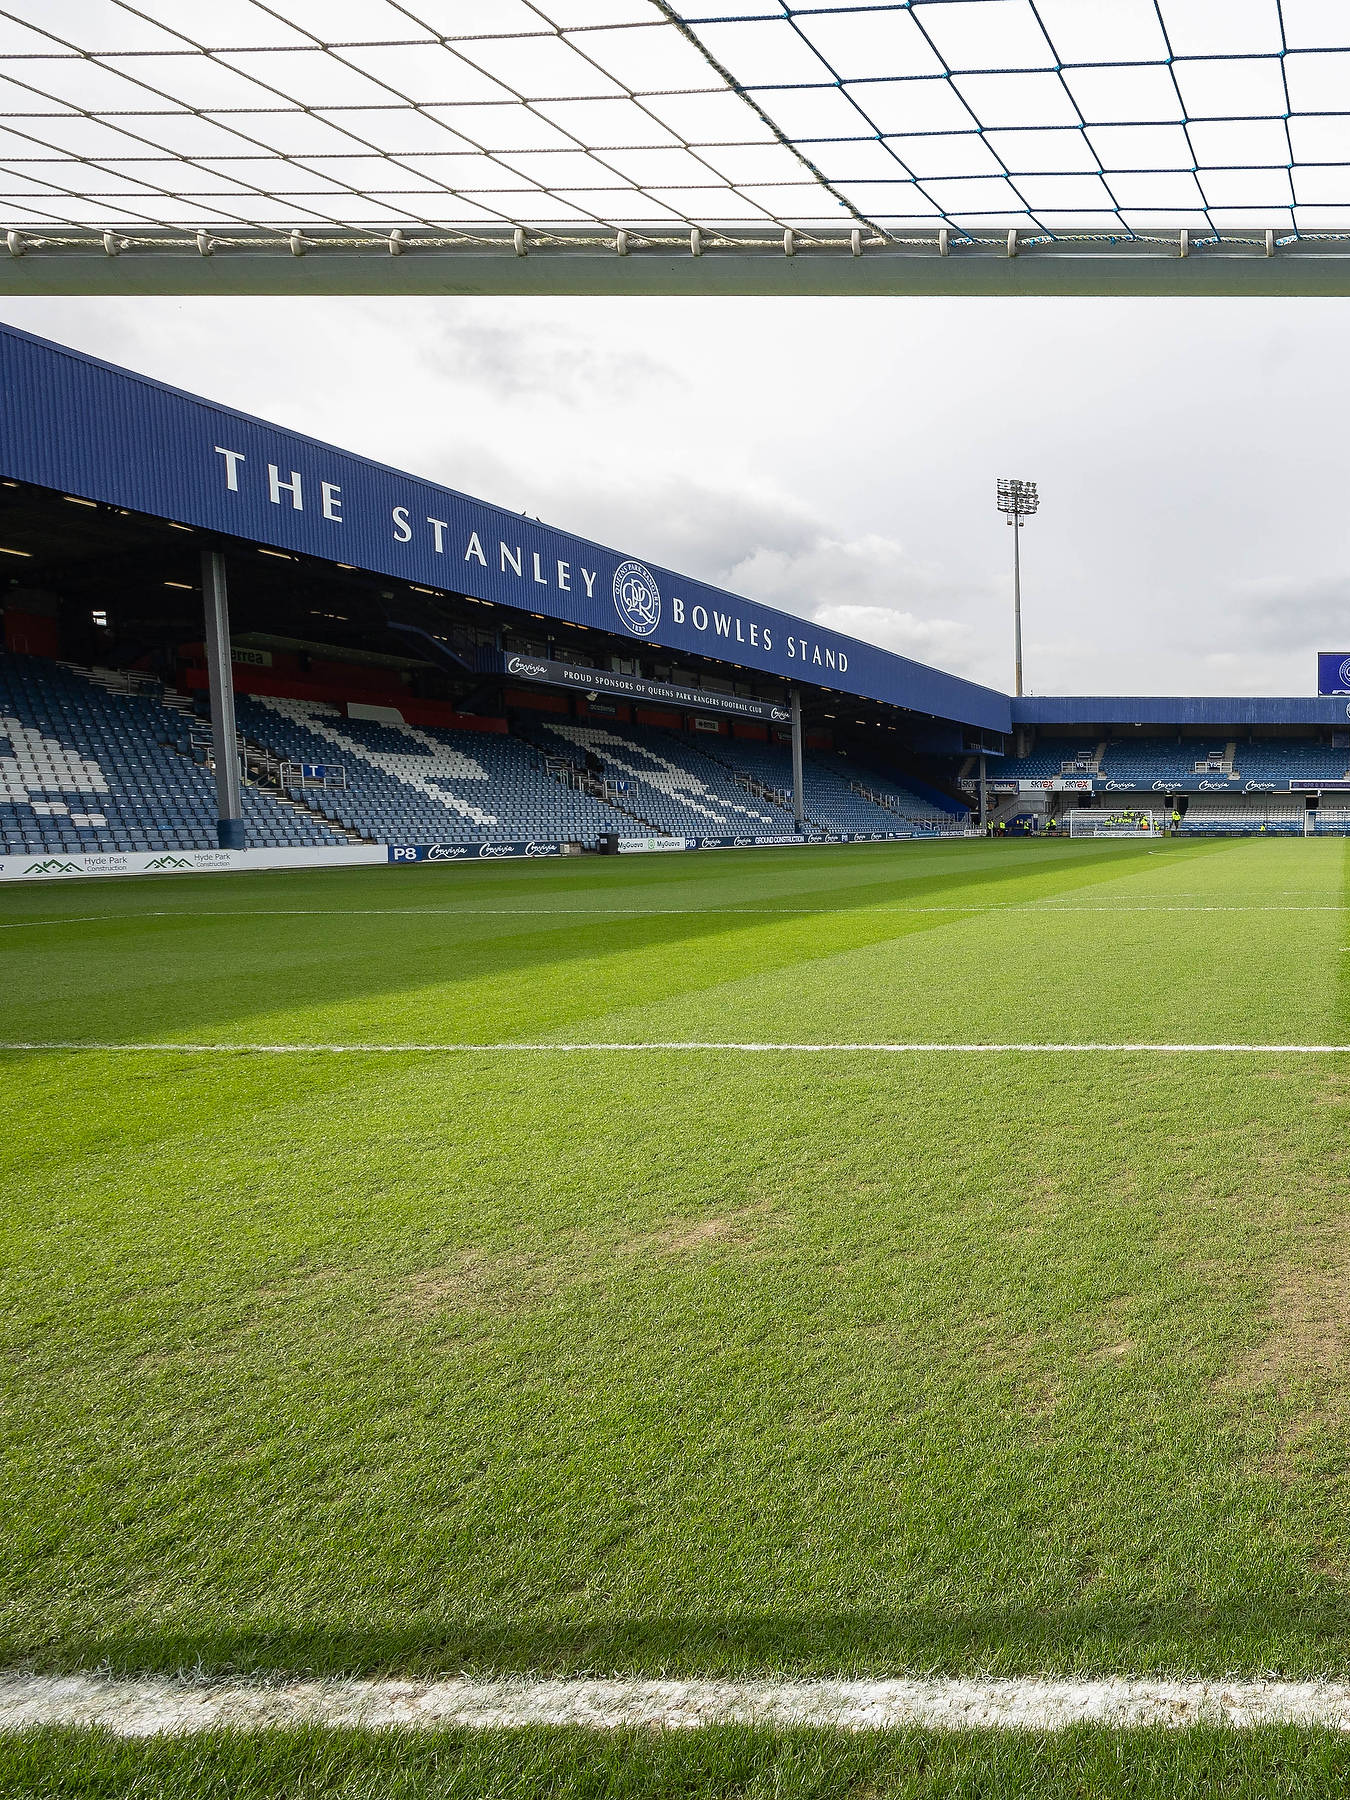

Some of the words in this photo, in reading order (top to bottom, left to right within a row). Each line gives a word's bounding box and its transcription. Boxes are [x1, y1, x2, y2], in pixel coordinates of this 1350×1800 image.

[214, 446, 343, 523] THE
[391, 506, 597, 598] STANLEY
[673, 597, 772, 651] BOWLES
[787, 636, 848, 673] STAND
[508, 657, 547, 675] Convivia
[564, 670, 592, 683] PROUD
[595, 676, 634, 690] SPONSORS
[636, 684, 645, 692] OF
[648, 686, 674, 697] QUEENS
[675, 691, 692, 701] PARK
[693, 695, 720, 706] RANGERS
[721, 700, 748, 712] FOOTBALL
[749, 705, 762, 714] CLUB
[309, 765, 318, 777] T
[656, 840, 681, 849] MyGuava
[685, 839, 696, 848] P10
[755, 836, 773, 845] GROUND
[773, 835, 804, 844] CONSTRUCTION
[394, 847, 417, 860] P8
[428, 844, 468, 860] Convivia
[479, 842, 515, 858] Convivia
[525, 841, 557, 856] Convivia
[84, 857, 108, 867] Hyde
[109, 856, 128, 864] Park
[194, 853, 213, 862] Hyde
[214, 852, 231, 861] Park
[86, 864, 127, 872] Construction
